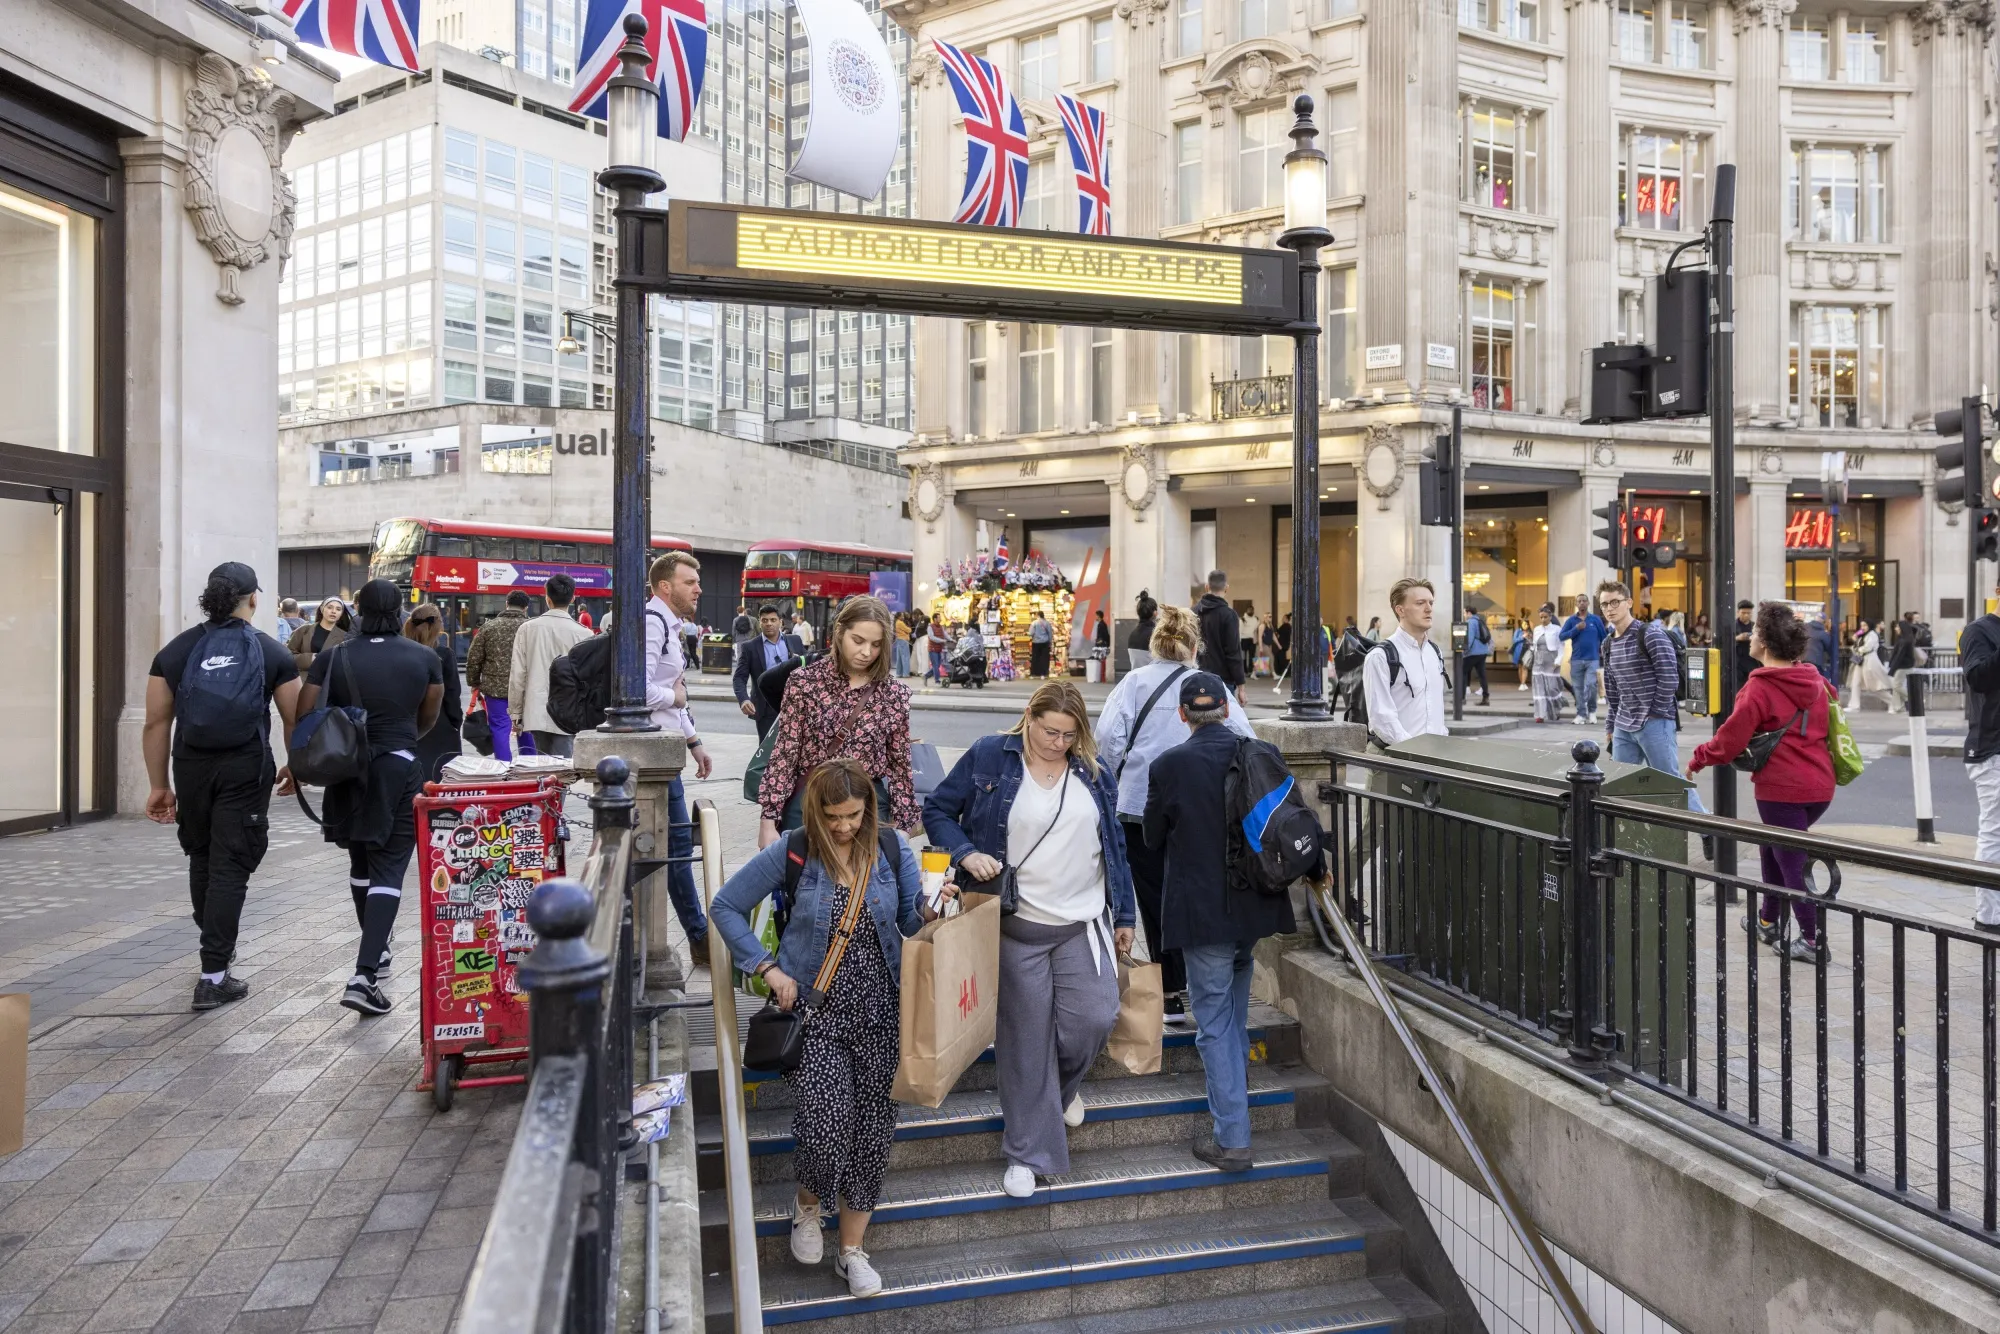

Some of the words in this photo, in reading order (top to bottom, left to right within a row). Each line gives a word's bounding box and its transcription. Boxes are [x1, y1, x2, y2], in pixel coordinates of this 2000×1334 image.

[763, 223, 921, 263] CAUTION
[938, 238, 1044, 273] FLOOR
[1057, 250, 1123, 279] AND
[1138, 256, 1226, 287] STEPS
[1245, 442, 1270, 460] H&M
[1513, 440, 1534, 458] H&M
[1673, 449, 1694, 466] H&M
[1020, 460, 1039, 477] H&M
[1785, 510, 1833, 549] H&M
[436, 575, 465, 584] Metroline
[779, 581, 790, 589] 159
[208, 656, 234, 664] NIKE
[457, 979, 485, 989] BRASS
[958, 971, 978, 1021] H&M
[436, 1026, 482, 1037] J'EXISTE.
